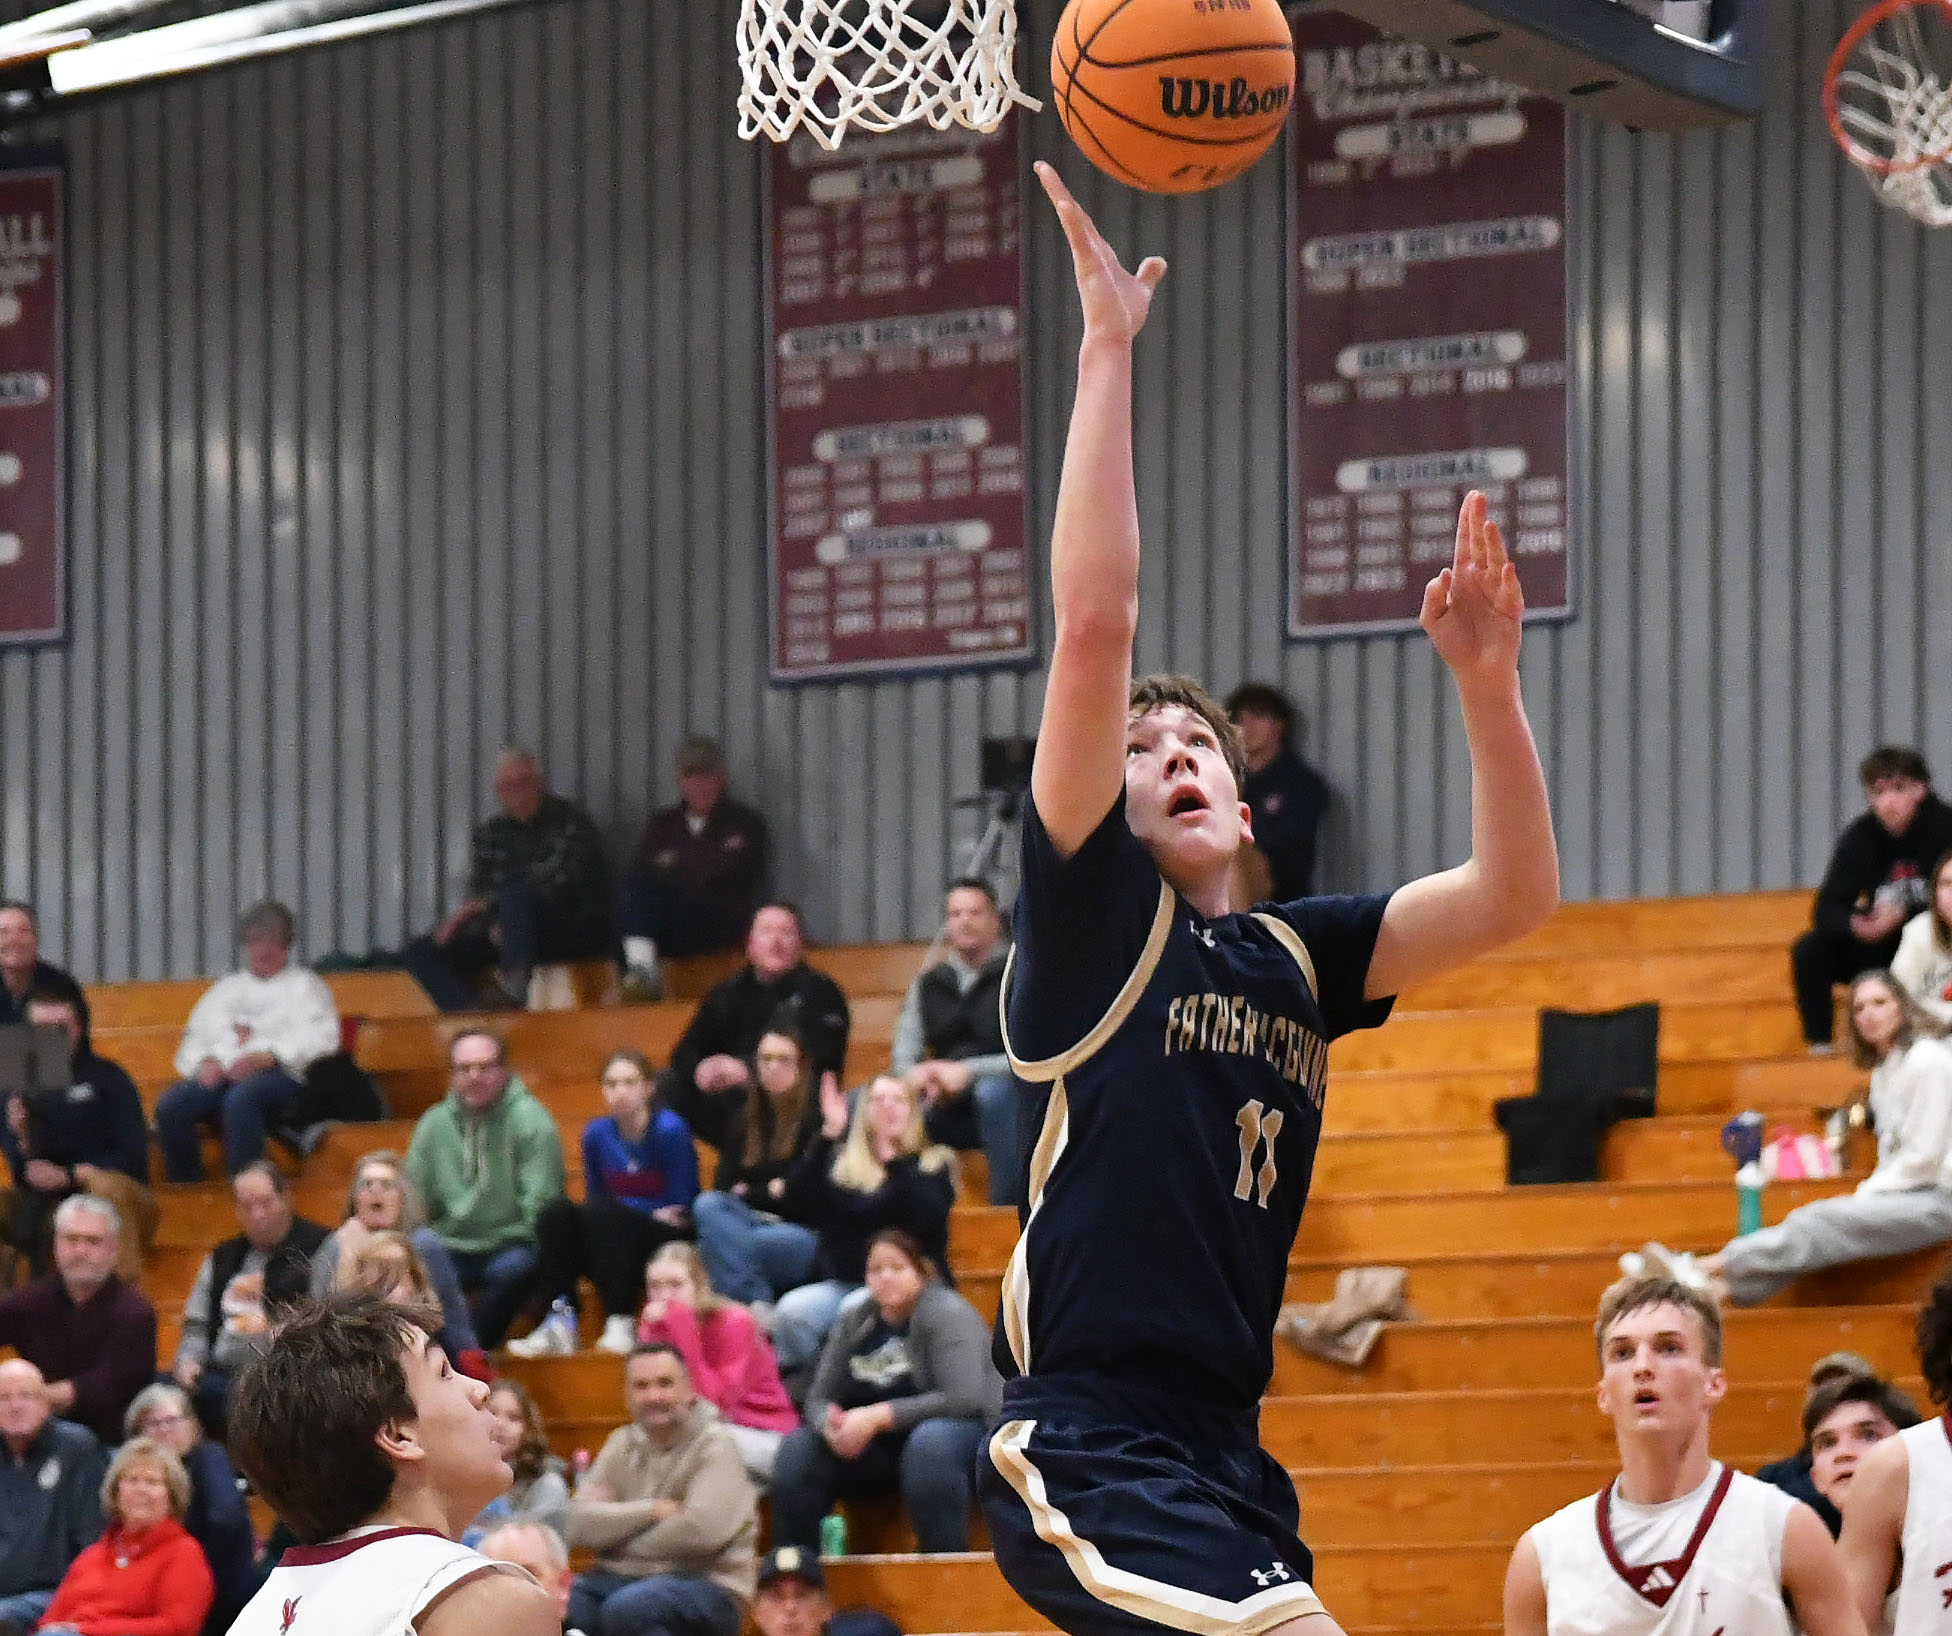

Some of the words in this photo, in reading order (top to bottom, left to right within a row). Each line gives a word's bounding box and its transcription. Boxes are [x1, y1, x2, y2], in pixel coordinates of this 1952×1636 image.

[1159, 75, 1291, 119] Wilson
[1165, 992, 1258, 1056] FATHER
[1234, 1099, 1284, 1210] 11
